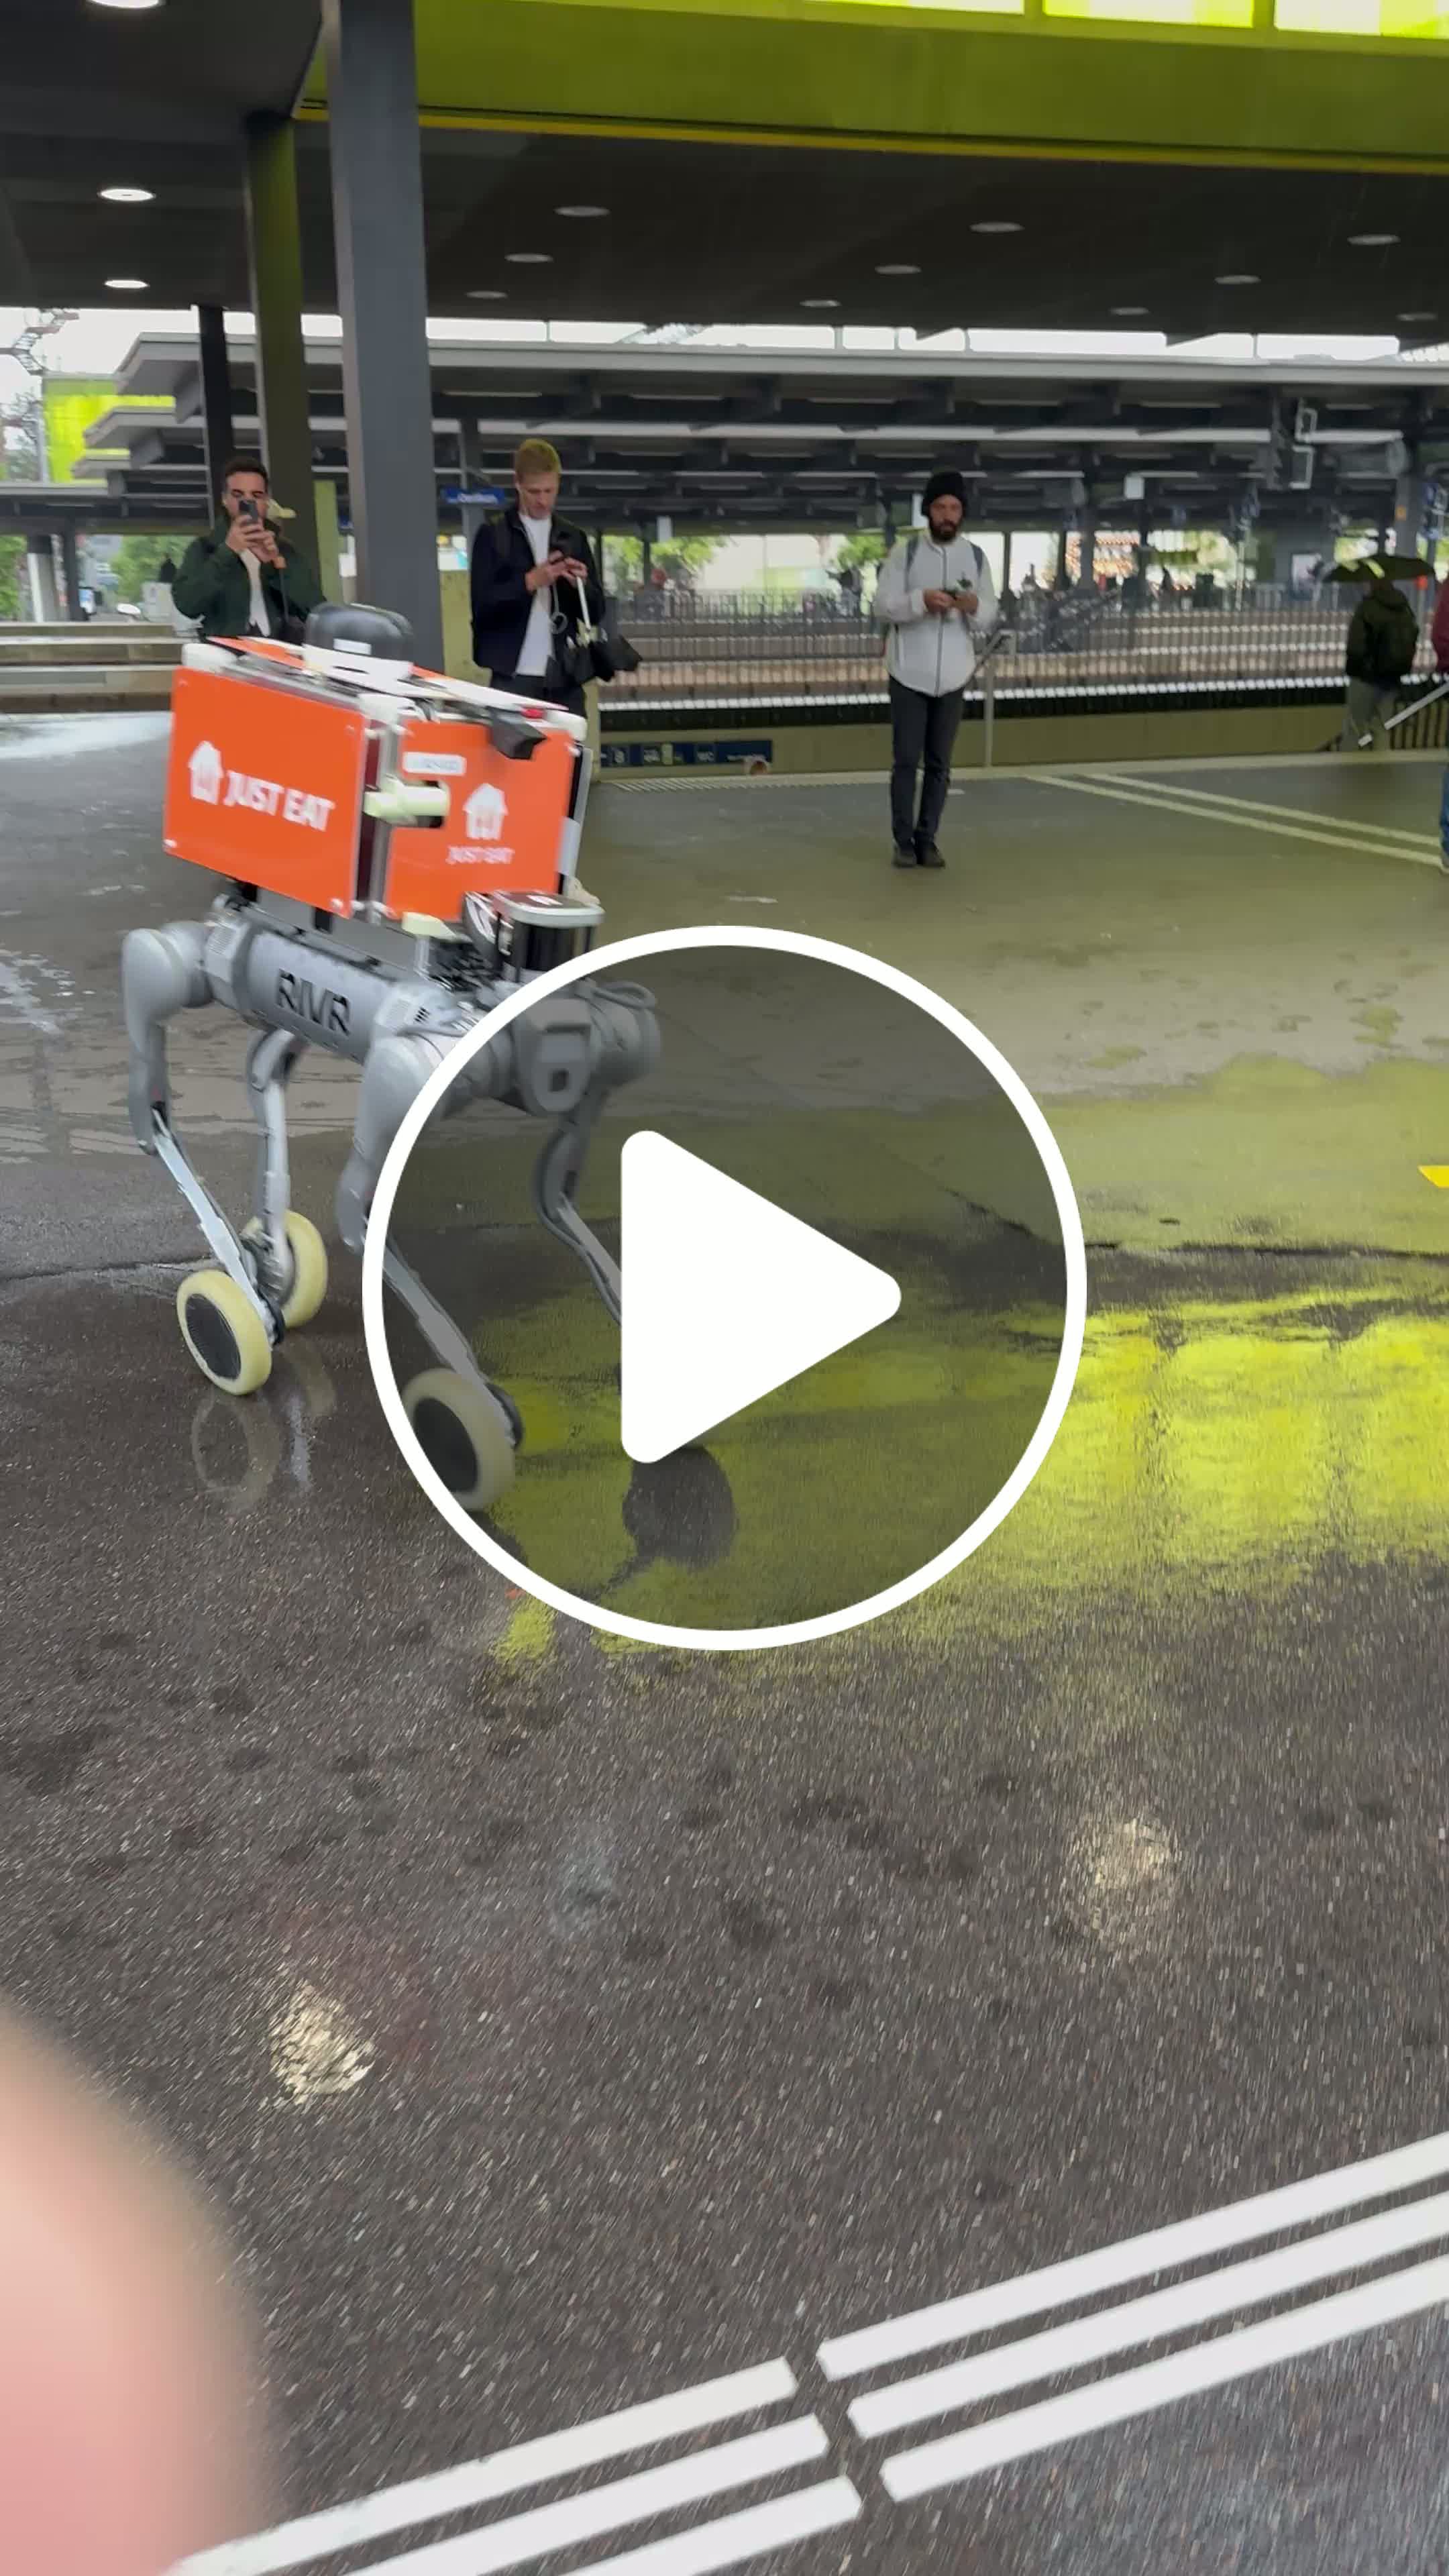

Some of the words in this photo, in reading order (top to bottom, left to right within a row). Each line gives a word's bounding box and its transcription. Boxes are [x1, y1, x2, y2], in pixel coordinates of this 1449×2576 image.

[223, 770, 285, 816] JUST
[282, 788, 336, 832] EAT
[276, 969, 351, 1036] RIVR
